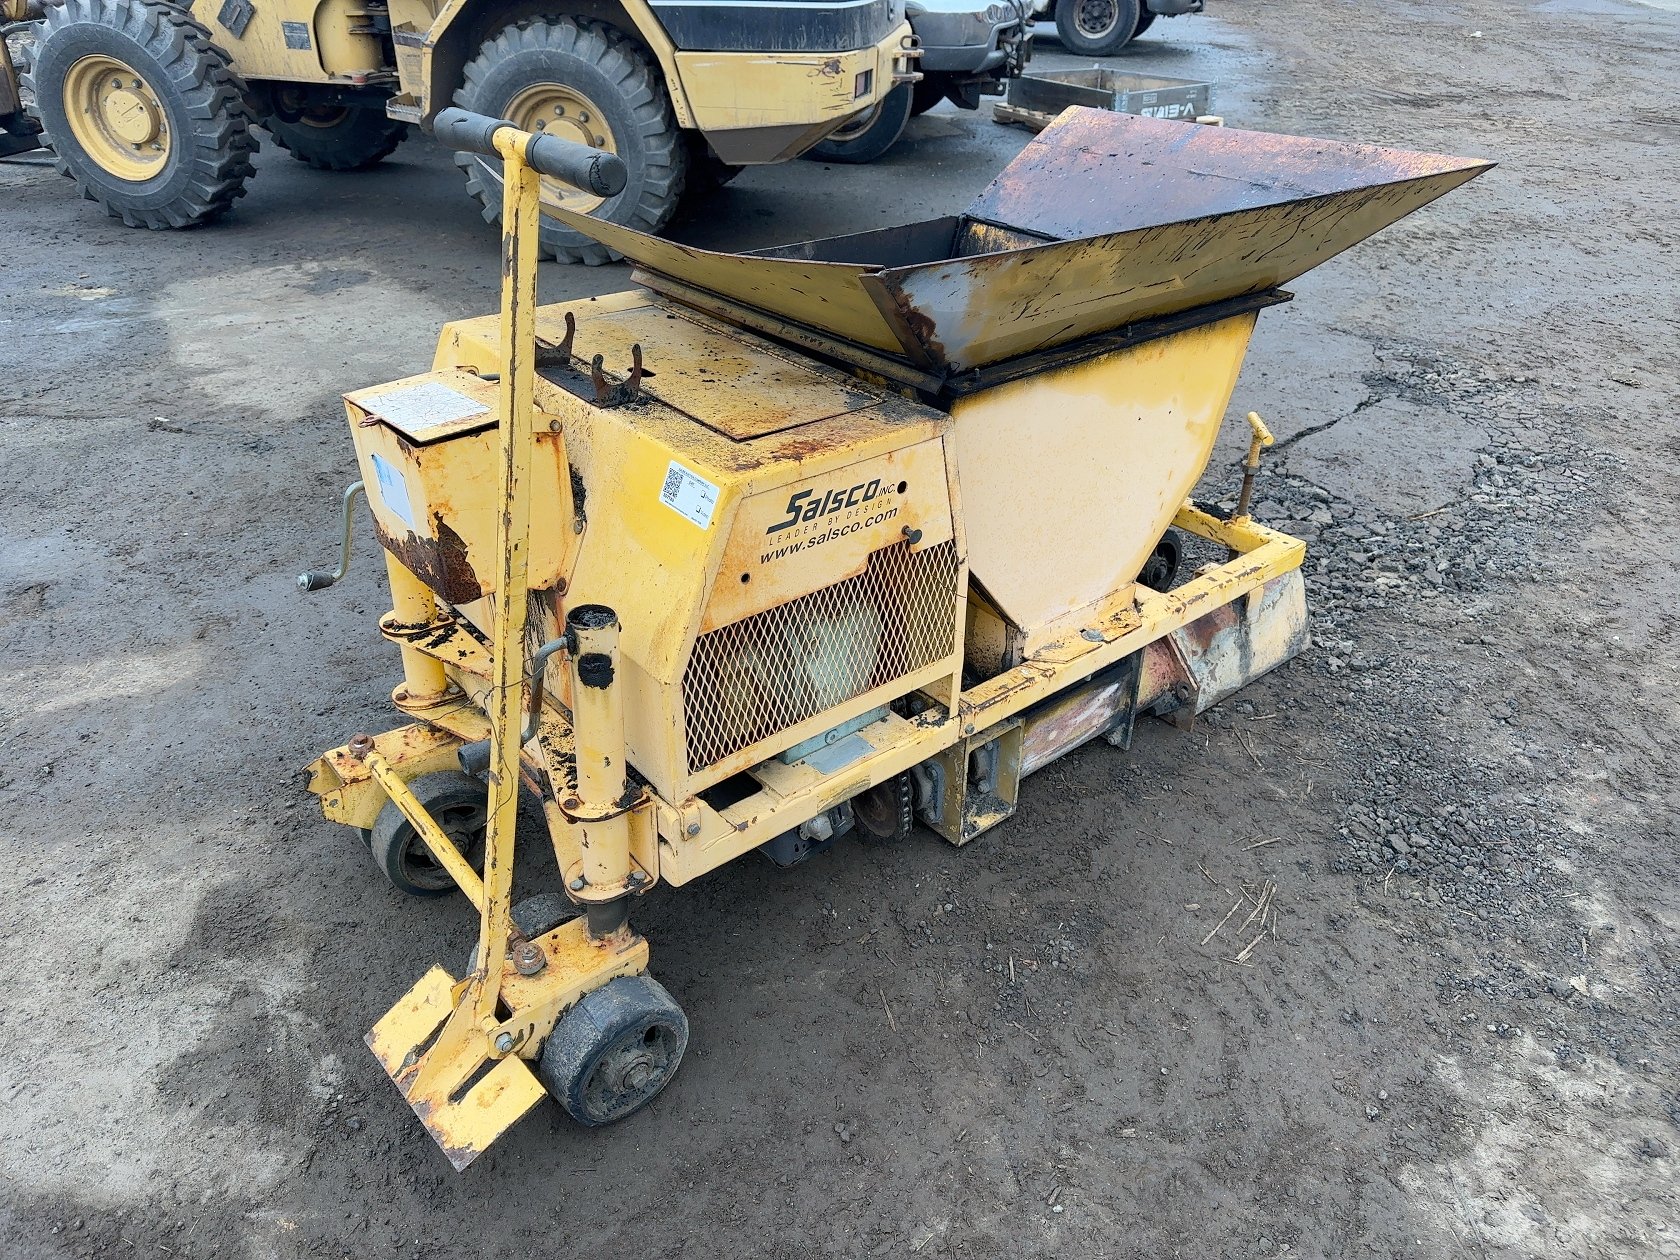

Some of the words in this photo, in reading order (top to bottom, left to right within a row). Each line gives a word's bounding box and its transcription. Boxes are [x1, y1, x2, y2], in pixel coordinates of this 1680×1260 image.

[766, 478, 881, 535] Salsco
[769, 522, 818, 546] LEADER
[828, 515, 840, 526] BY
[846, 498, 892, 520] DESIGN
[760, 507, 898, 565] www.salsco.com
